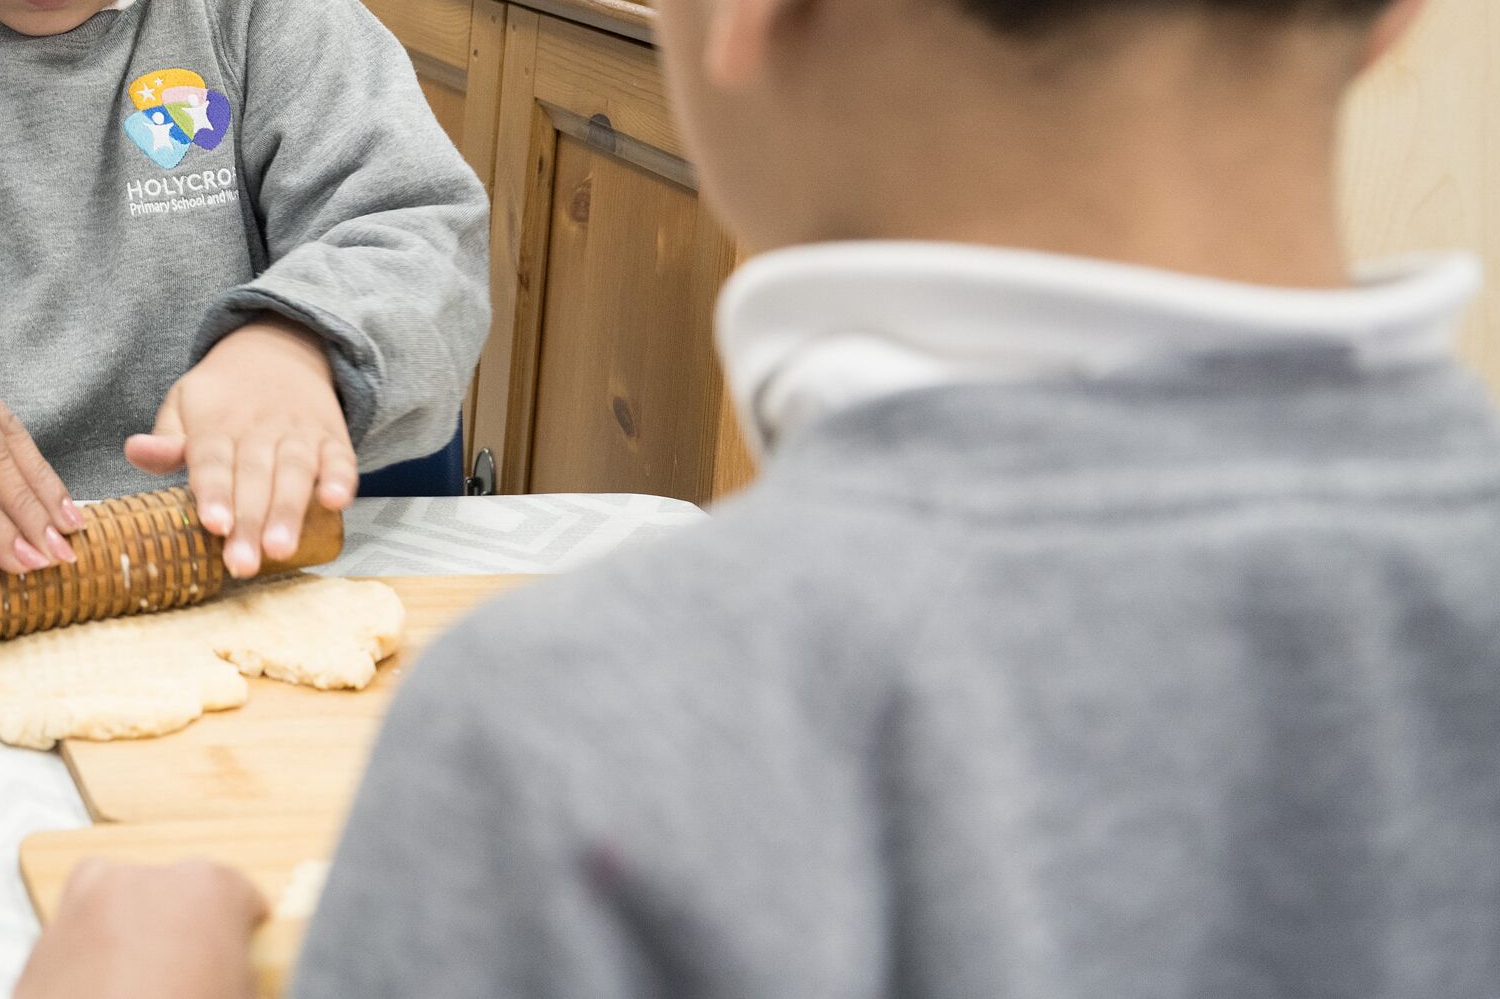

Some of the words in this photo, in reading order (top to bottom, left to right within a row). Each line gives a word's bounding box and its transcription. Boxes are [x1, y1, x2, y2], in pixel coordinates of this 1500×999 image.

[130, 200, 170, 216] Primary
[171, 194, 206, 212] School
[206, 189, 226, 204] and
